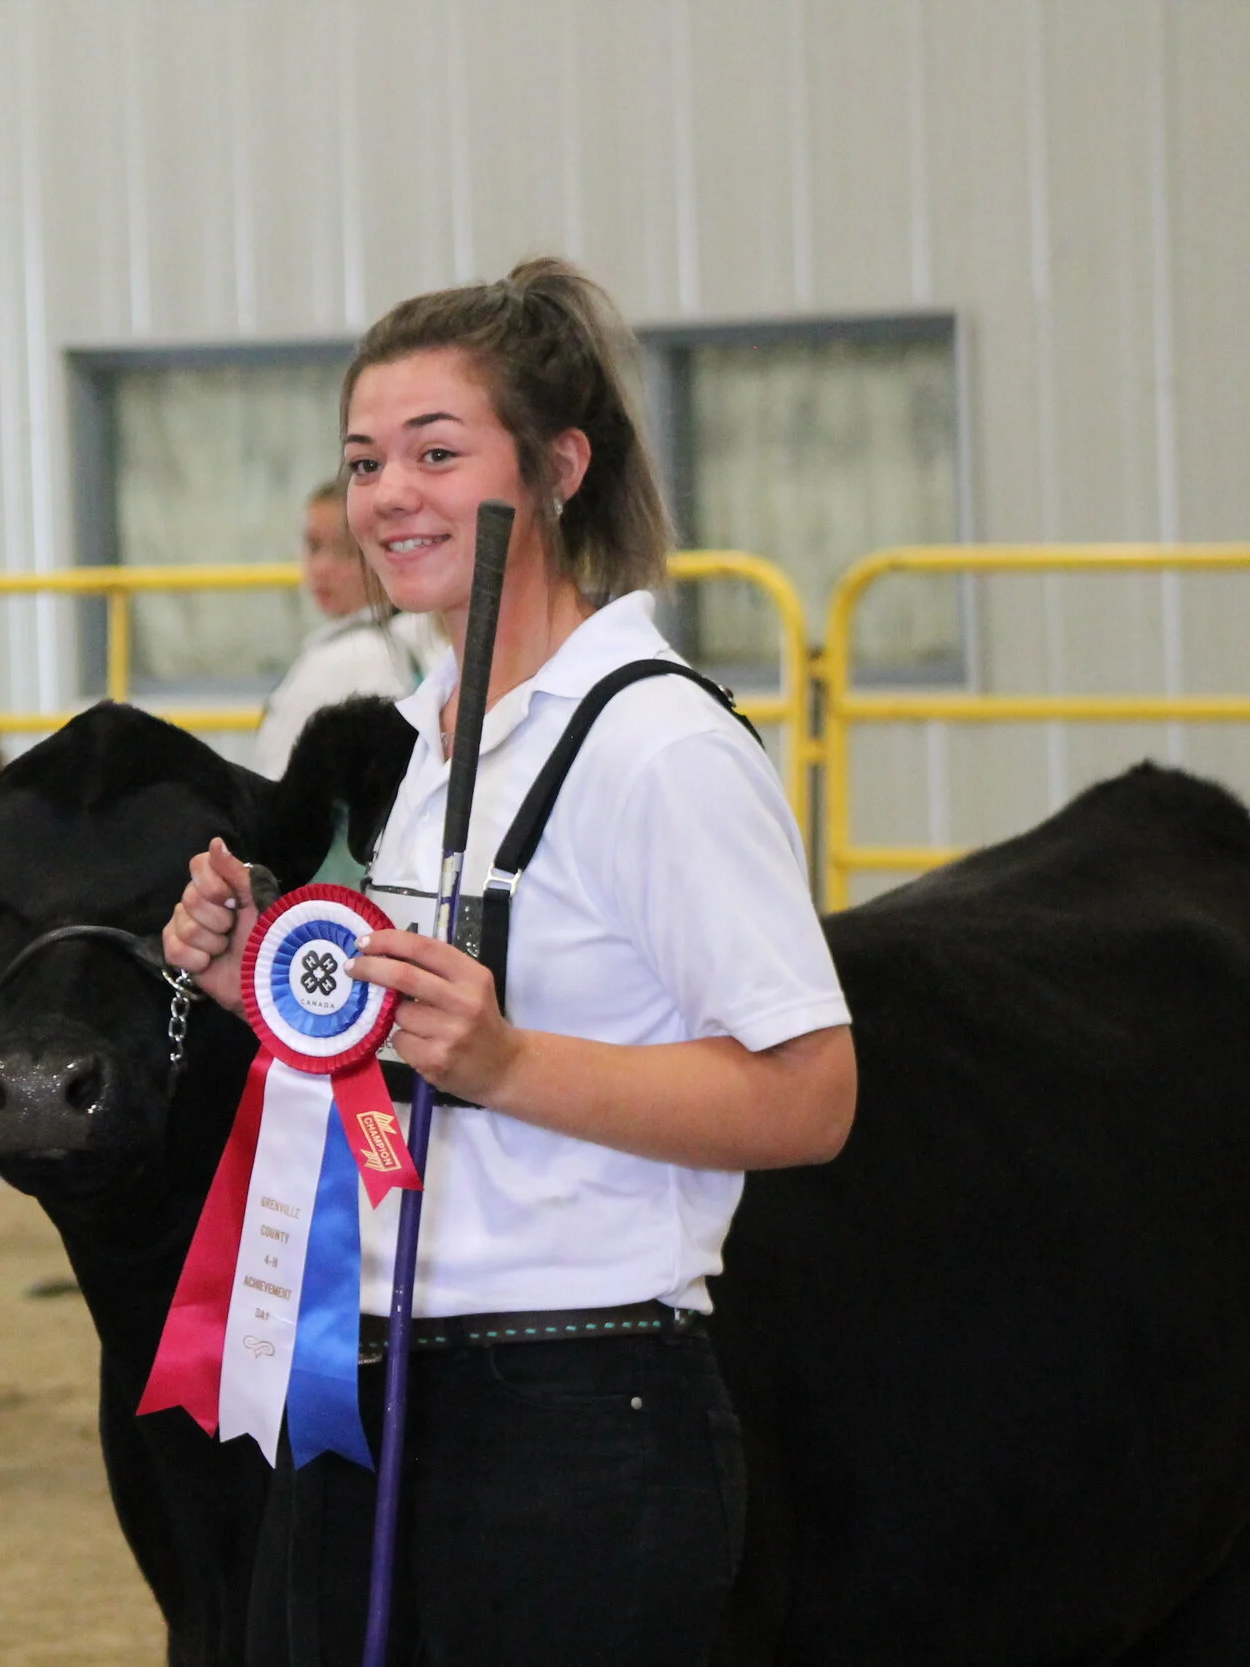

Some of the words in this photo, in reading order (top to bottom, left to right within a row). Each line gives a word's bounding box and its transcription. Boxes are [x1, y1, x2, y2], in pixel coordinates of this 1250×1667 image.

[300, 998, 335, 1009] CANADA
[363, 1117, 393, 1166] CHAMPION
[260, 1196, 301, 1219] GRENVILLE
[260, 1225, 290, 1244] COUNTY
[264, 1254, 278, 1268] 4-H
[243, 1276, 293, 1300] ACHIEVEMENT
[254, 1307, 270, 1320] DAY
